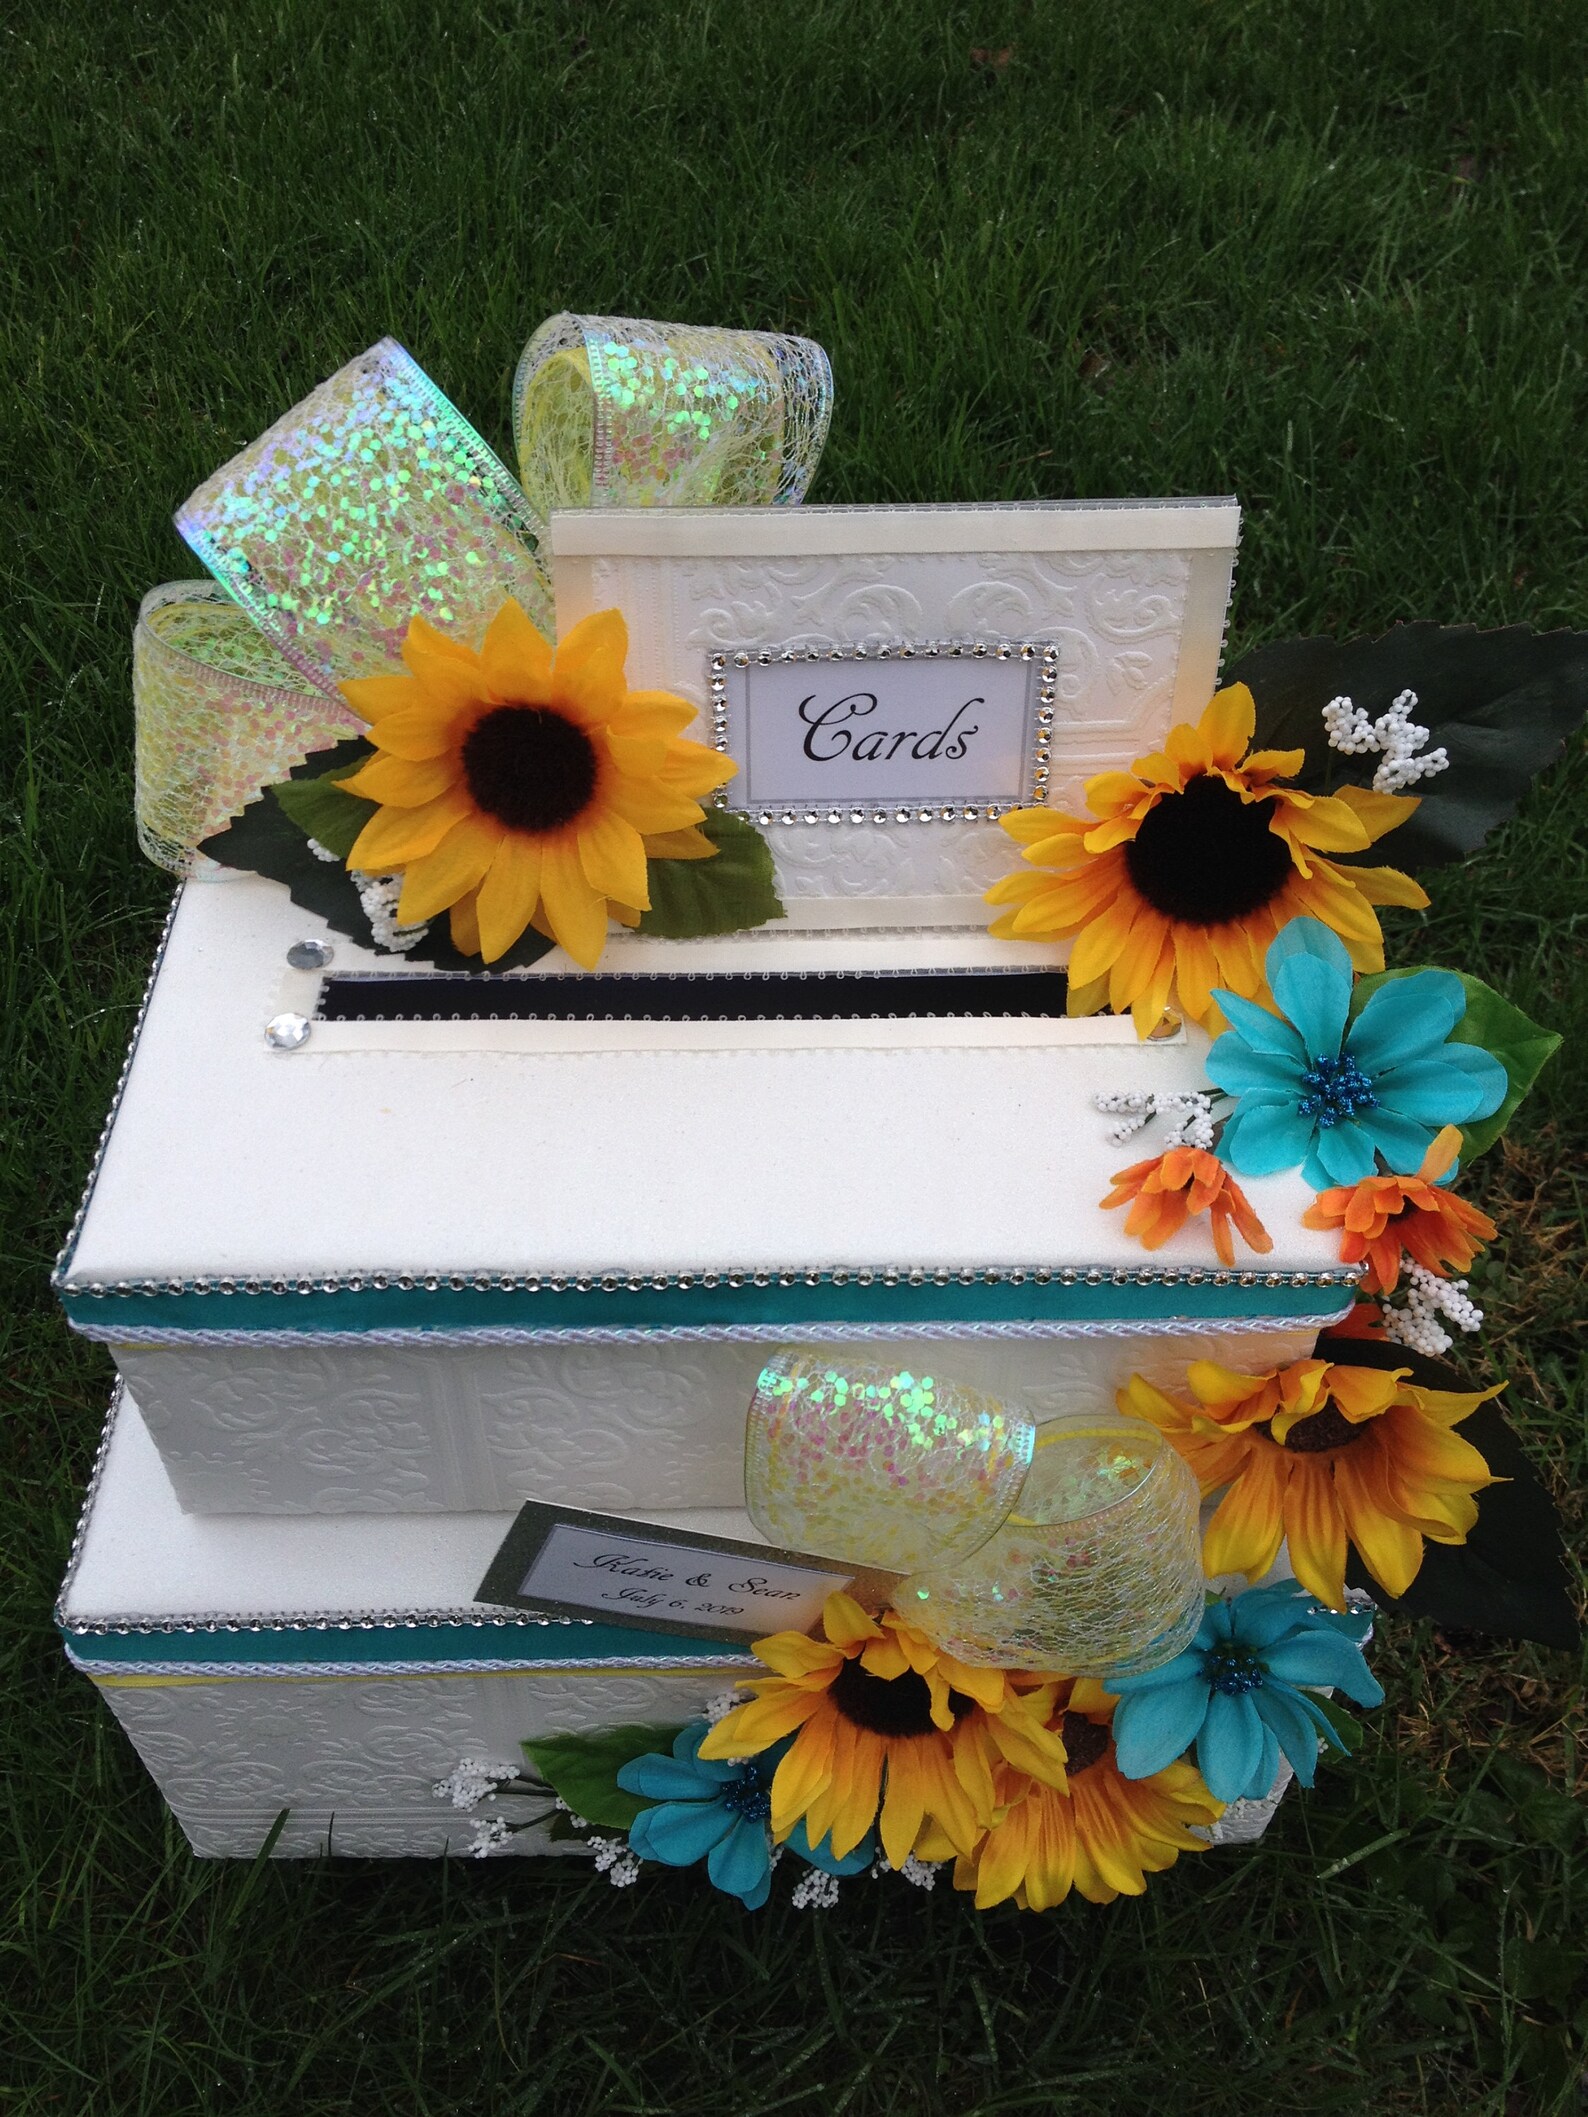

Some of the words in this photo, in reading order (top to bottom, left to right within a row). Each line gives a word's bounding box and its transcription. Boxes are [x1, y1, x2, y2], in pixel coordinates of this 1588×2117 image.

[798, 693, 985, 761] Cards
[573, 1553, 674, 1581] Katie
[685, 1572, 712, 1588] &
[728, 1577, 801, 1600] Sean
[601, 1587, 667, 1608] July
[694, 1602, 744, 1616] 2019
